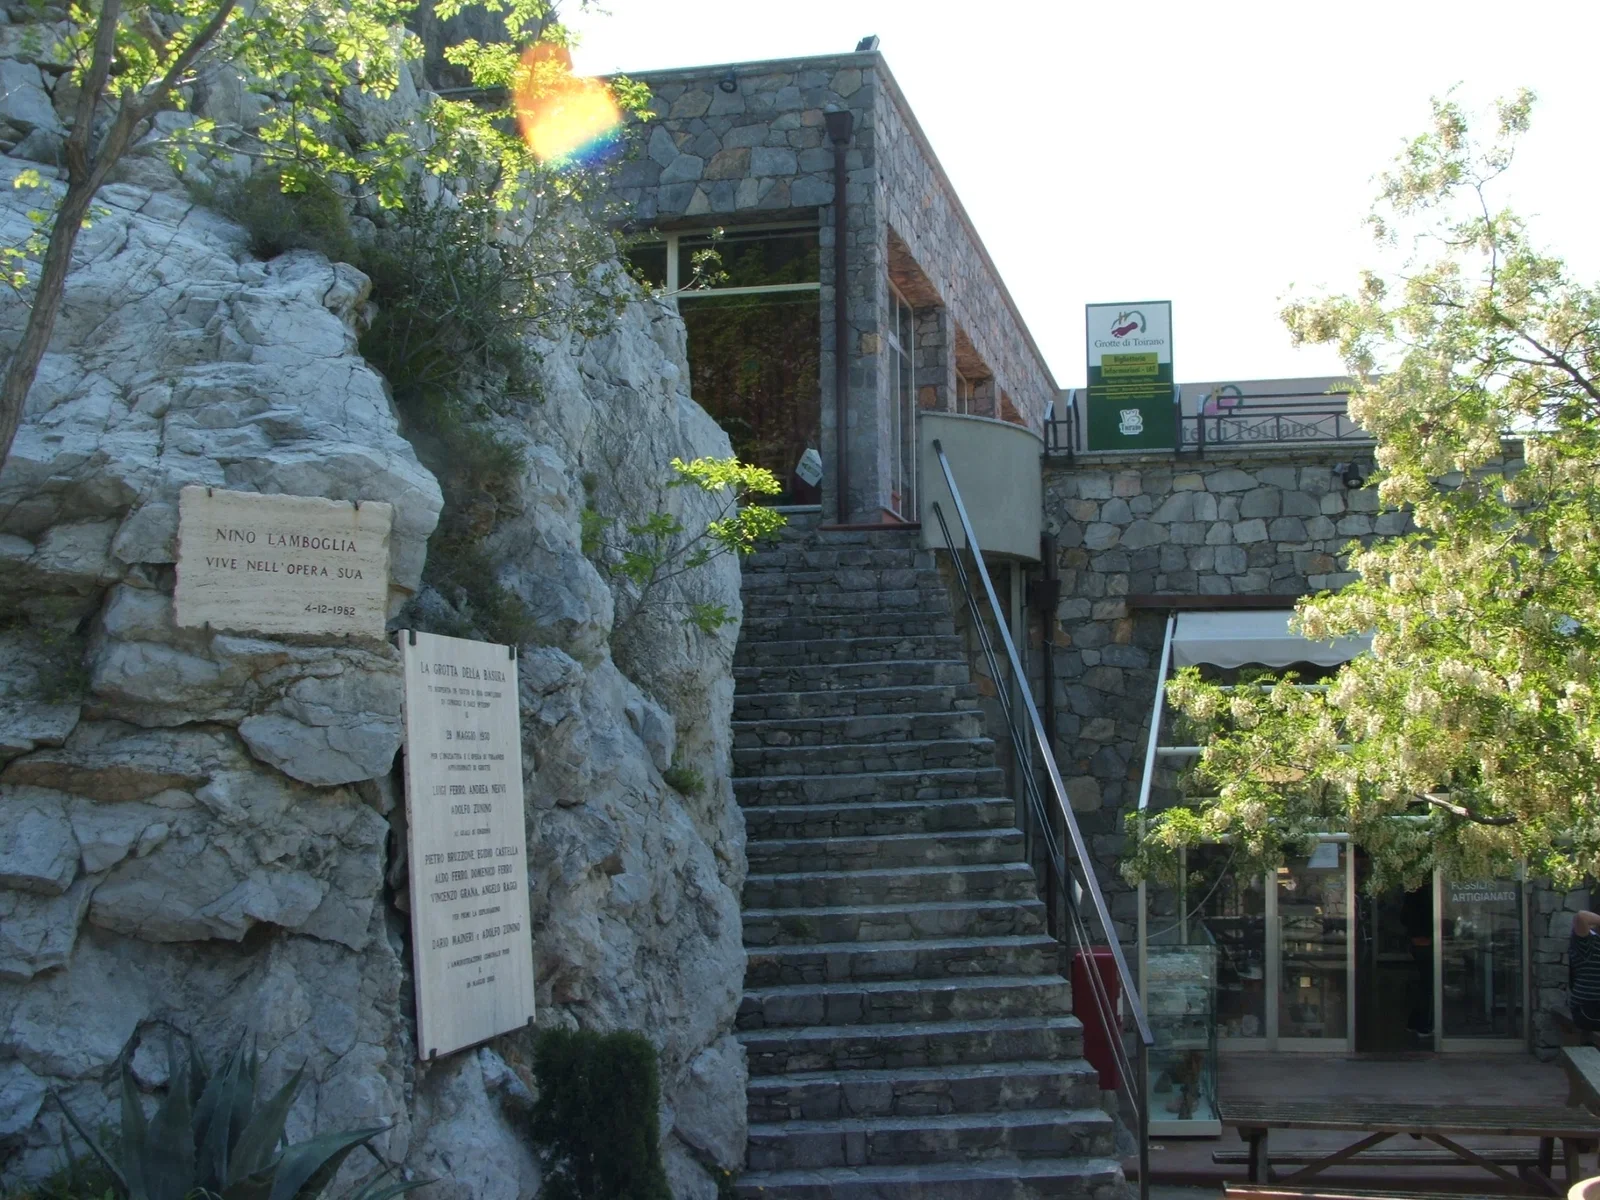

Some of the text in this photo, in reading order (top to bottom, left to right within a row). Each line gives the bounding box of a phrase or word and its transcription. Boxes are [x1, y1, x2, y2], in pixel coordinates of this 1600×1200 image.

[1094, 337, 1165, 348] Grotte di Toirano
[1234, 419, 1318, 441] Toirano
[216, 528, 357, 552] NINO LAMBOGLIA
[206, 557, 237, 569] VIVE
[337, 567, 363, 580] SUA
[420, 661, 430, 674] LA
[433, 663, 458, 678] GROTTA
[462, 666, 481, 680] DELLA
[456, 730, 476, 741] MAGGIO
[469, 784, 489, 795] ANDREA
[451, 803, 492, 815] ADOLFO ZUNINO
[425, 853, 444, 865] PIETRO
[495, 845, 519, 857] CASTELLA
[435, 872, 449, 884] ALDO
[471, 866, 495, 879] DOMENICO
[497, 864, 512, 875] FERRO
[430, 890, 457, 903] VINCENZO
[481, 883, 501, 896] ANGELO
[1452, 891, 1516, 902] ARTIGIANATO
[432, 937, 449, 950] DARIO
[482, 926, 501, 939] ADOLFO
[502, 922, 520, 935] ZUNINO
